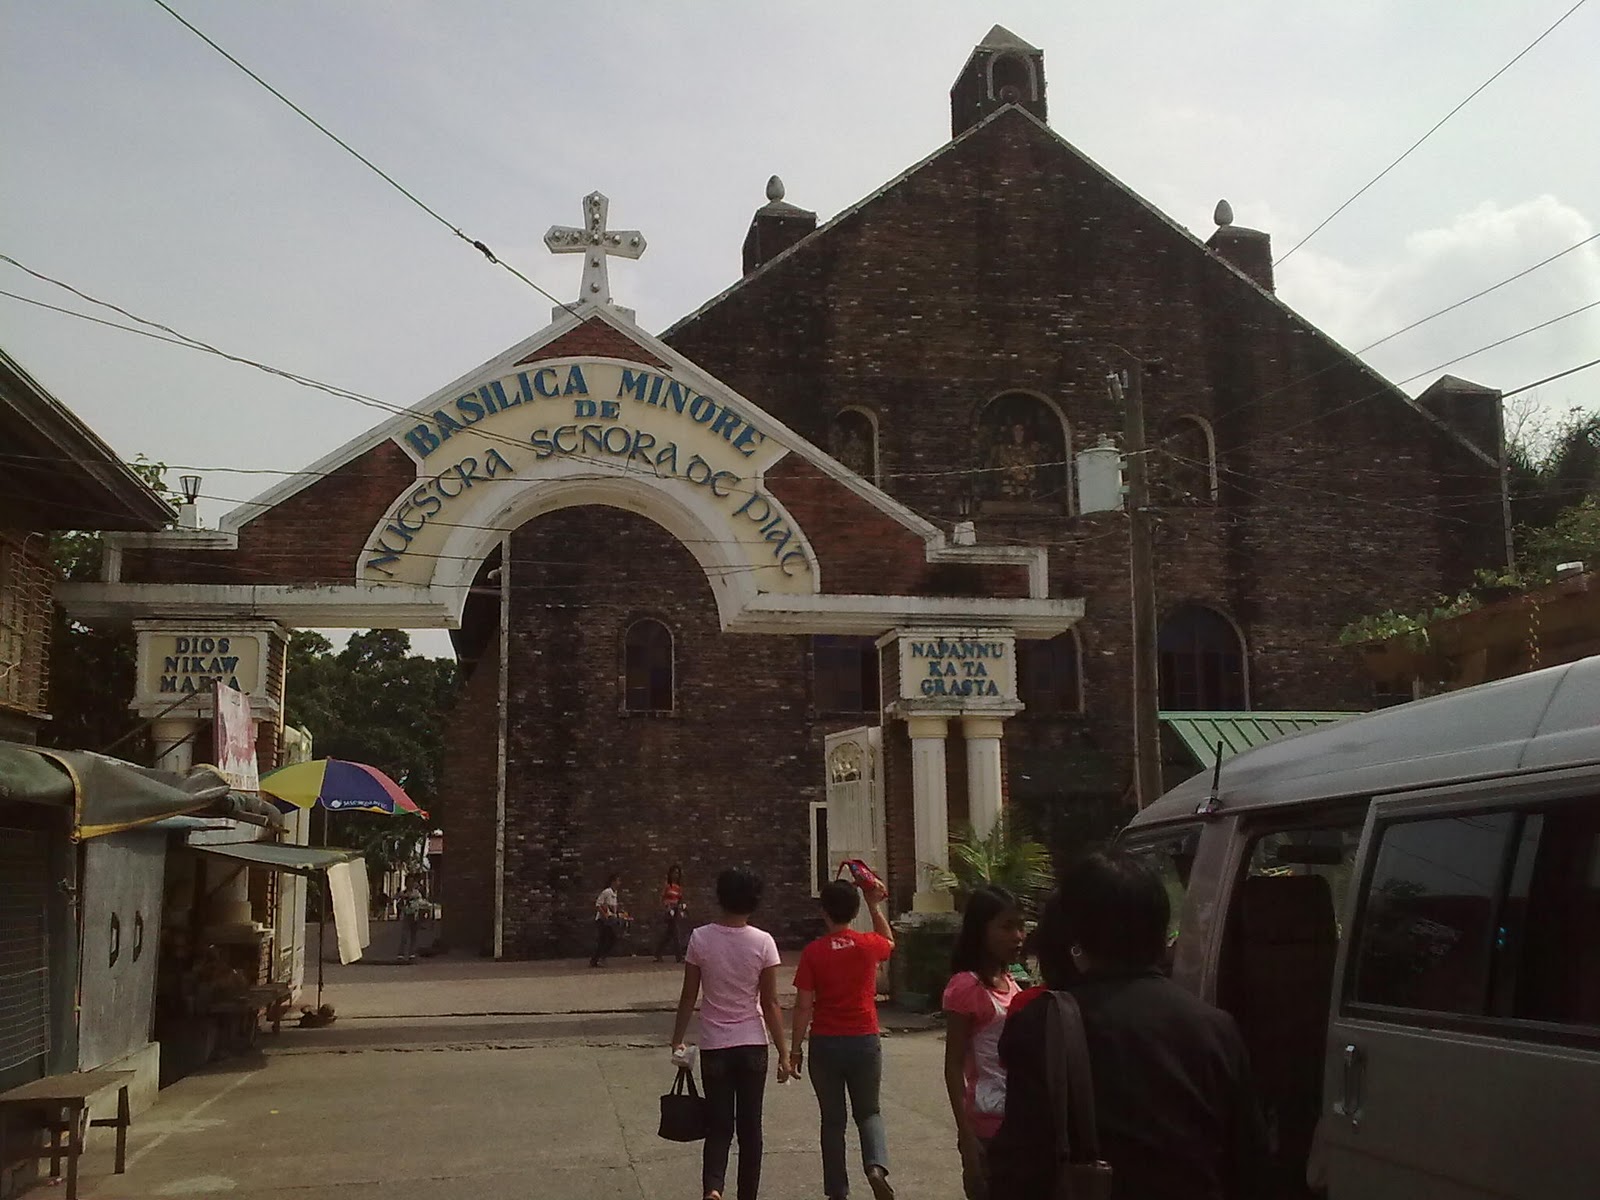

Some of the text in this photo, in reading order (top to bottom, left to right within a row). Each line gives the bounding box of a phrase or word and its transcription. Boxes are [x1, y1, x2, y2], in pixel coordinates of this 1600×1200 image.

[405, 365, 767, 459] BASILICA MINORE
[575, 400, 621, 419] DE
[366, 448, 513, 577] NUESTRA
[176, 637, 230, 654] DIOS
[911, 642, 1003, 659] NAPANNU
[164, 656, 239, 673] NIKAW
[160, 675, 241, 693] MARA
